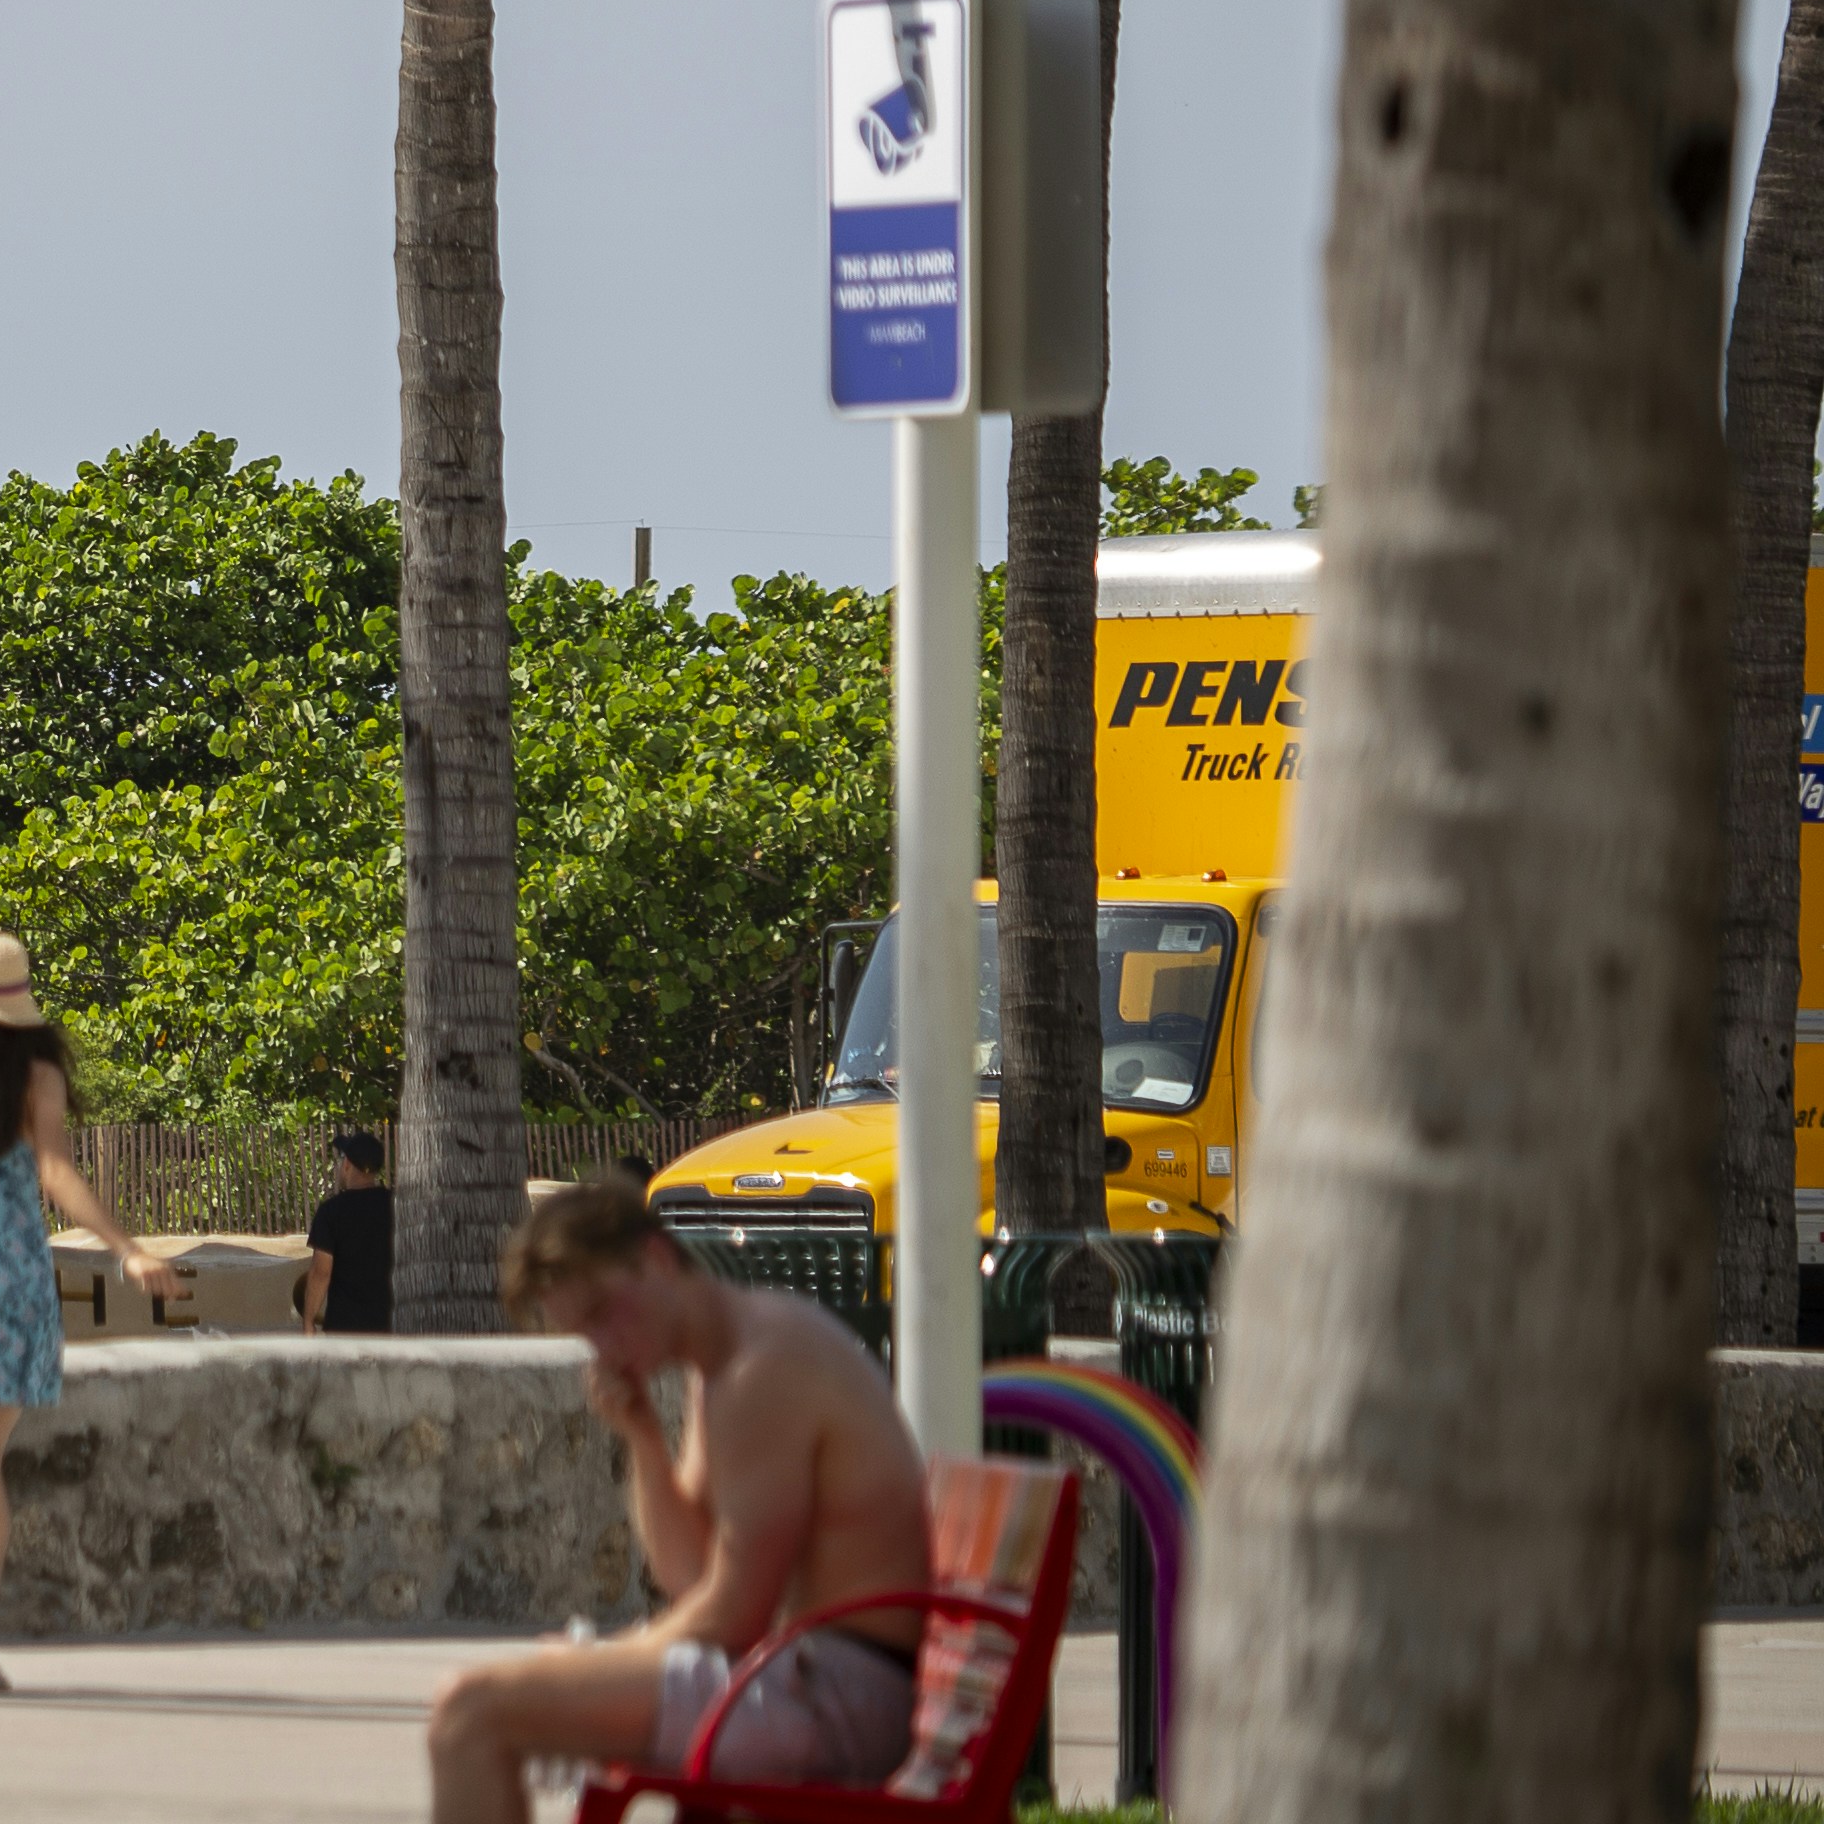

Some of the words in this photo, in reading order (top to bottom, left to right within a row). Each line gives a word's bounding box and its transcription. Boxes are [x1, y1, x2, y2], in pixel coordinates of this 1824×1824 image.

[840, 256, 868, 281] THIS
[869, 254, 901, 278] AREA
[903, 253, 914, 276] IS
[916, 249, 955, 275] UNDER
[838, 285, 876, 309] VIDEO
[878, 280, 958, 307] SURVEILLANCE
[1181, 743, 1270, 781] Truck
